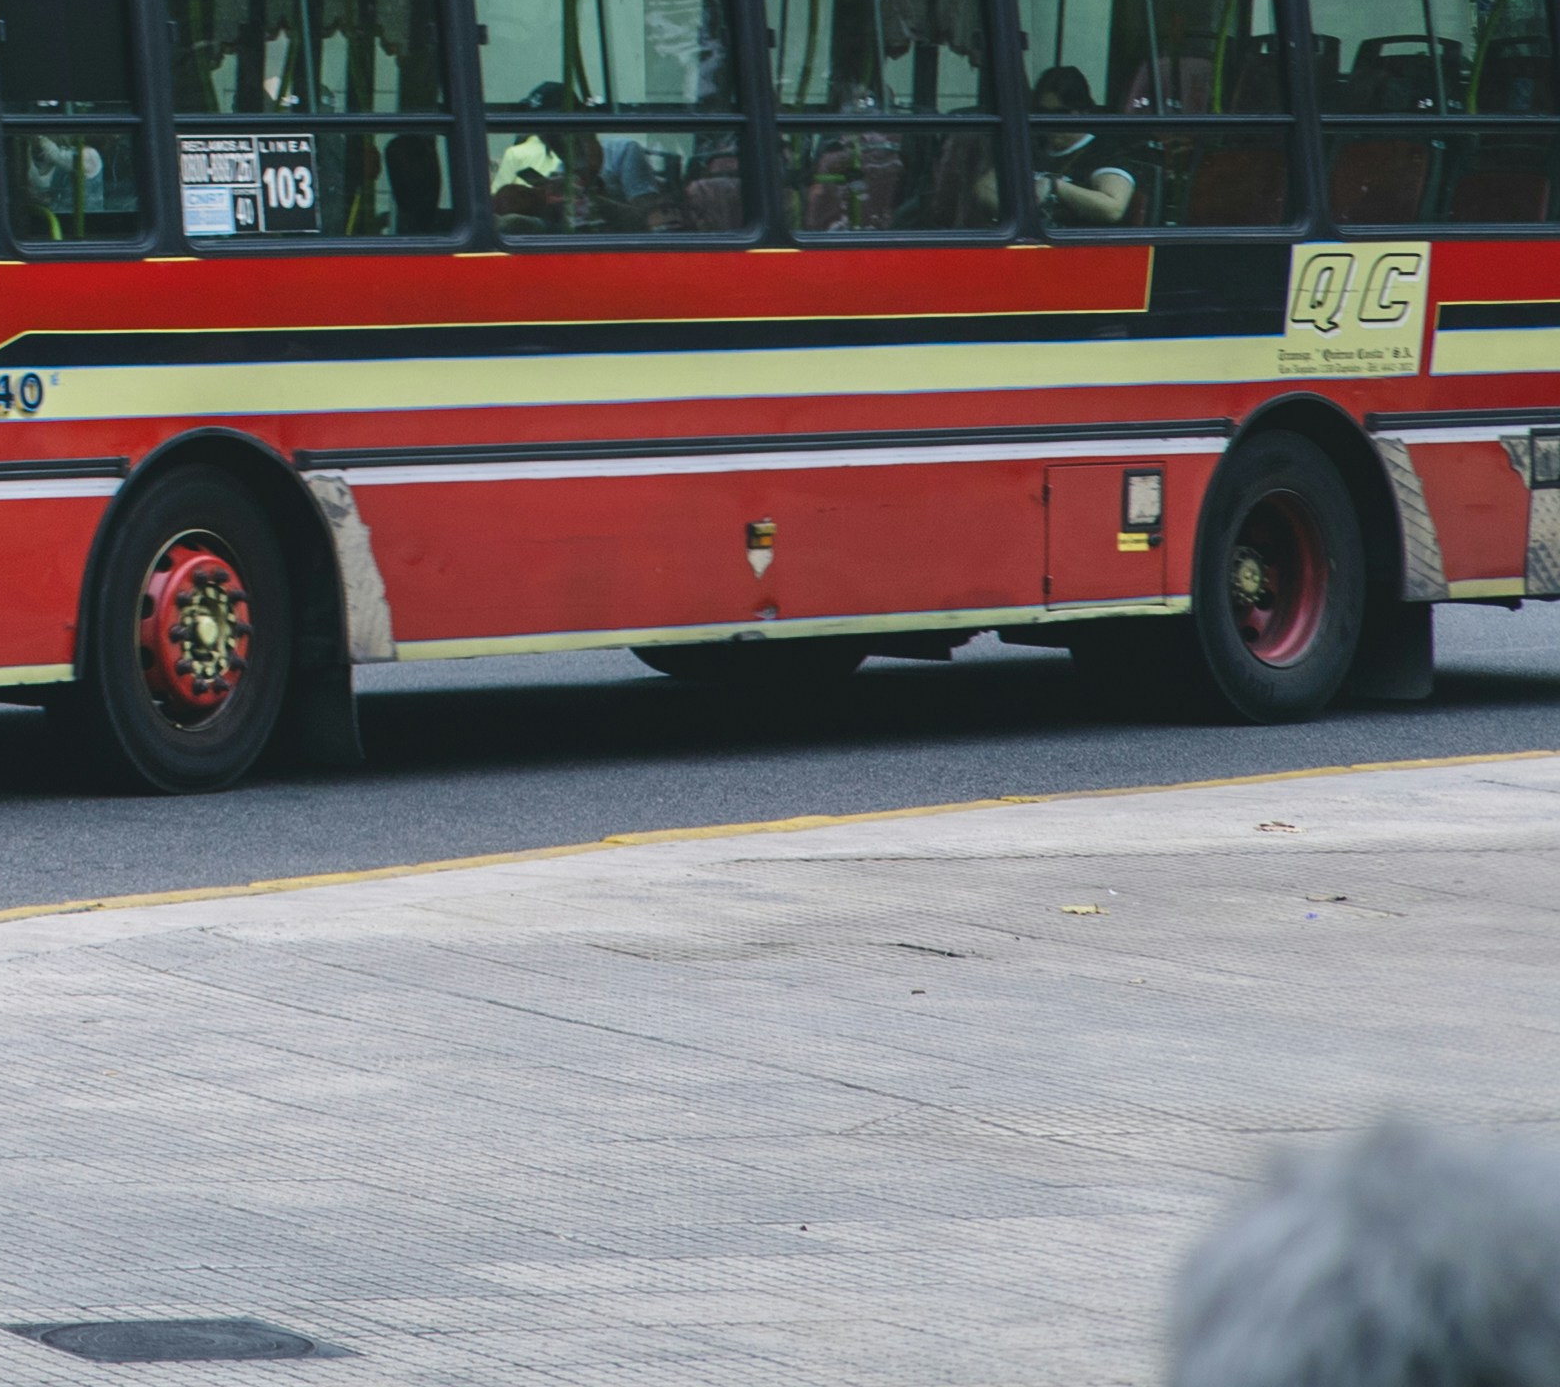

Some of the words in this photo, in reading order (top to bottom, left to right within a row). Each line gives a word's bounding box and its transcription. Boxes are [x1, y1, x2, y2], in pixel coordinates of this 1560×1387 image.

[259, 141, 312, 153] LINEA
[263, 166, 314, 209] 103
[1290, 253, 1423, 337] QC
